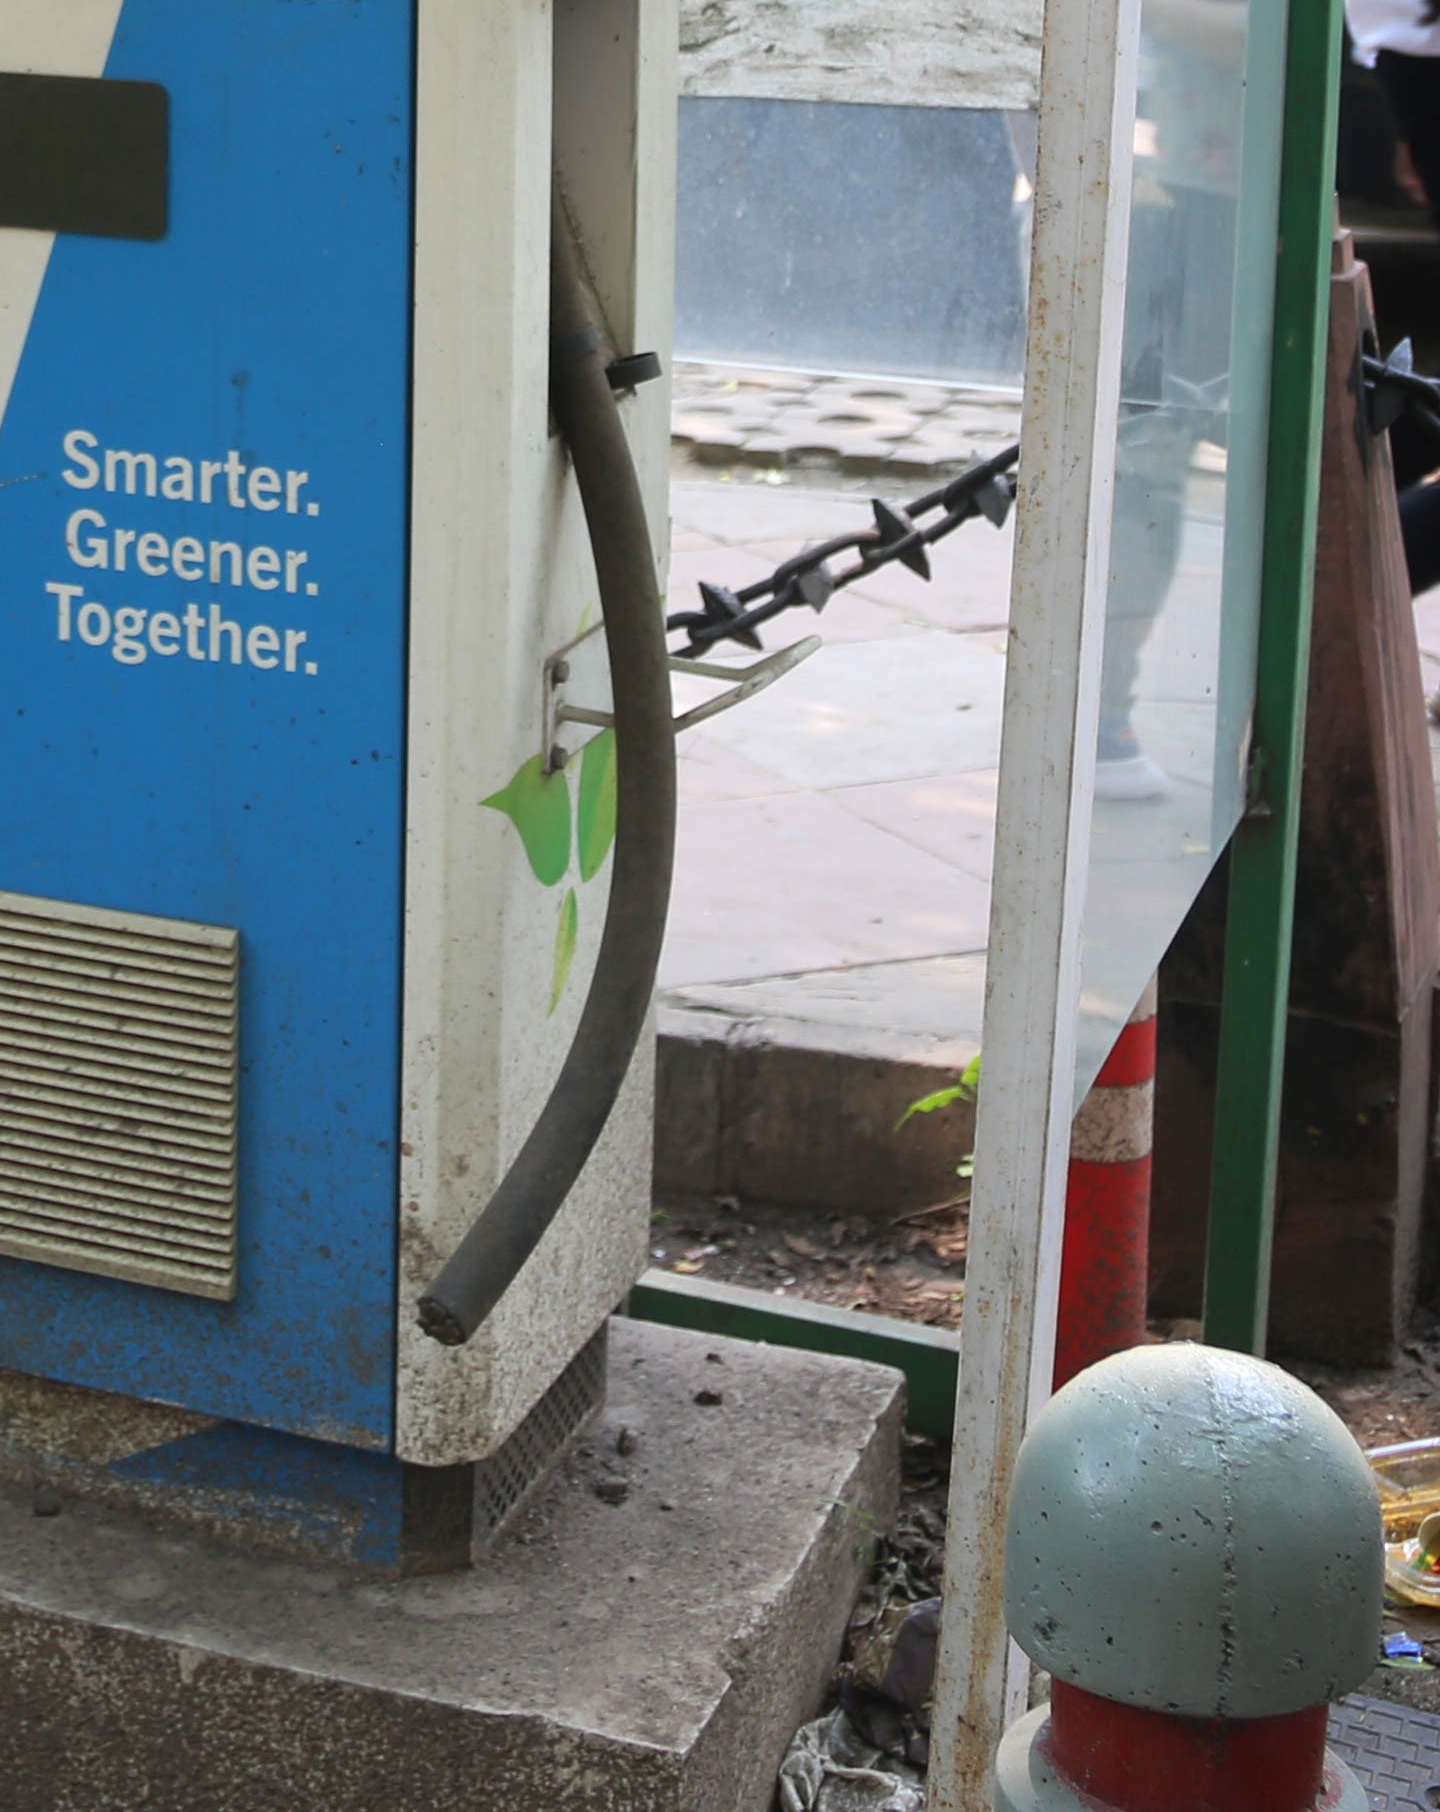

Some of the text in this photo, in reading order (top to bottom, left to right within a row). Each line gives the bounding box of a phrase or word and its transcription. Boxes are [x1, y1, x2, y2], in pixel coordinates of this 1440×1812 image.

[62, 429, 320, 517] Smarter.
[65, 508, 320, 597] Greener.
[45, 582, 319, 676] Together.
